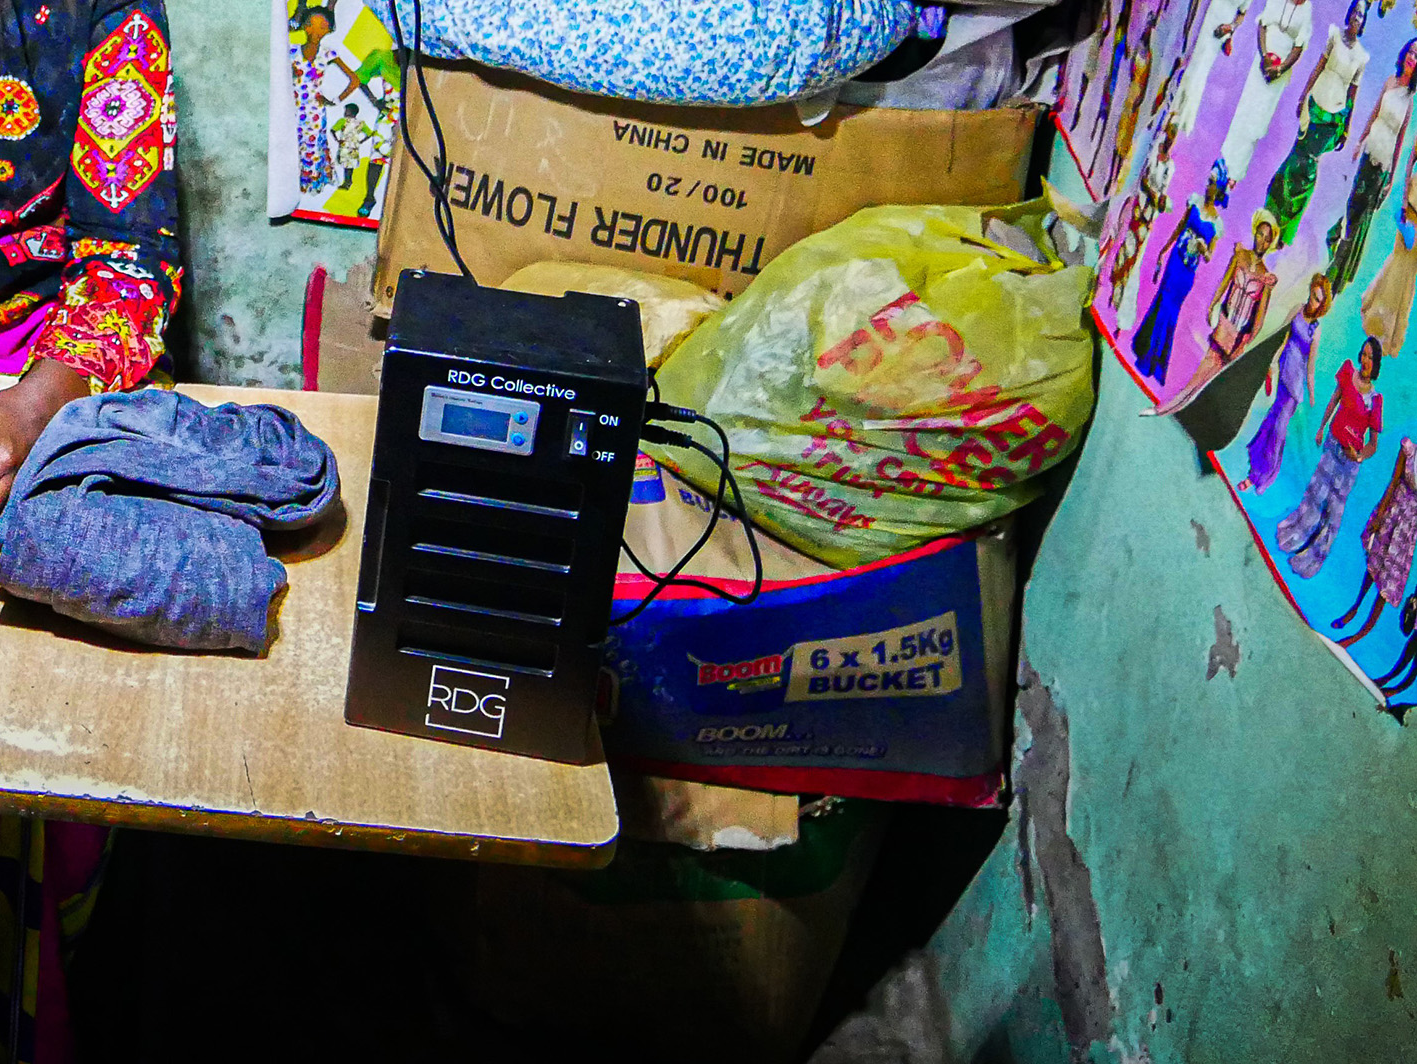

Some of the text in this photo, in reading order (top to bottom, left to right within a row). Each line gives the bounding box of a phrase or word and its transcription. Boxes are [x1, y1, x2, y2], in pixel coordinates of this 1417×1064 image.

[613, 119, 815, 176] MADE IN CHINA
[591, 205, 767, 276] THUNDER
[447, 369, 486, 387] RDG
[490, 376, 577, 401] Collective
[599, 413, 619, 427] ON
[591, 450, 616, 463] OFF
[810, 648, 830, 671] 6
[840, 650, 861, 669] x
[808, 660, 945, 695] BUCKET
[427, 683, 507, 720] RDG
